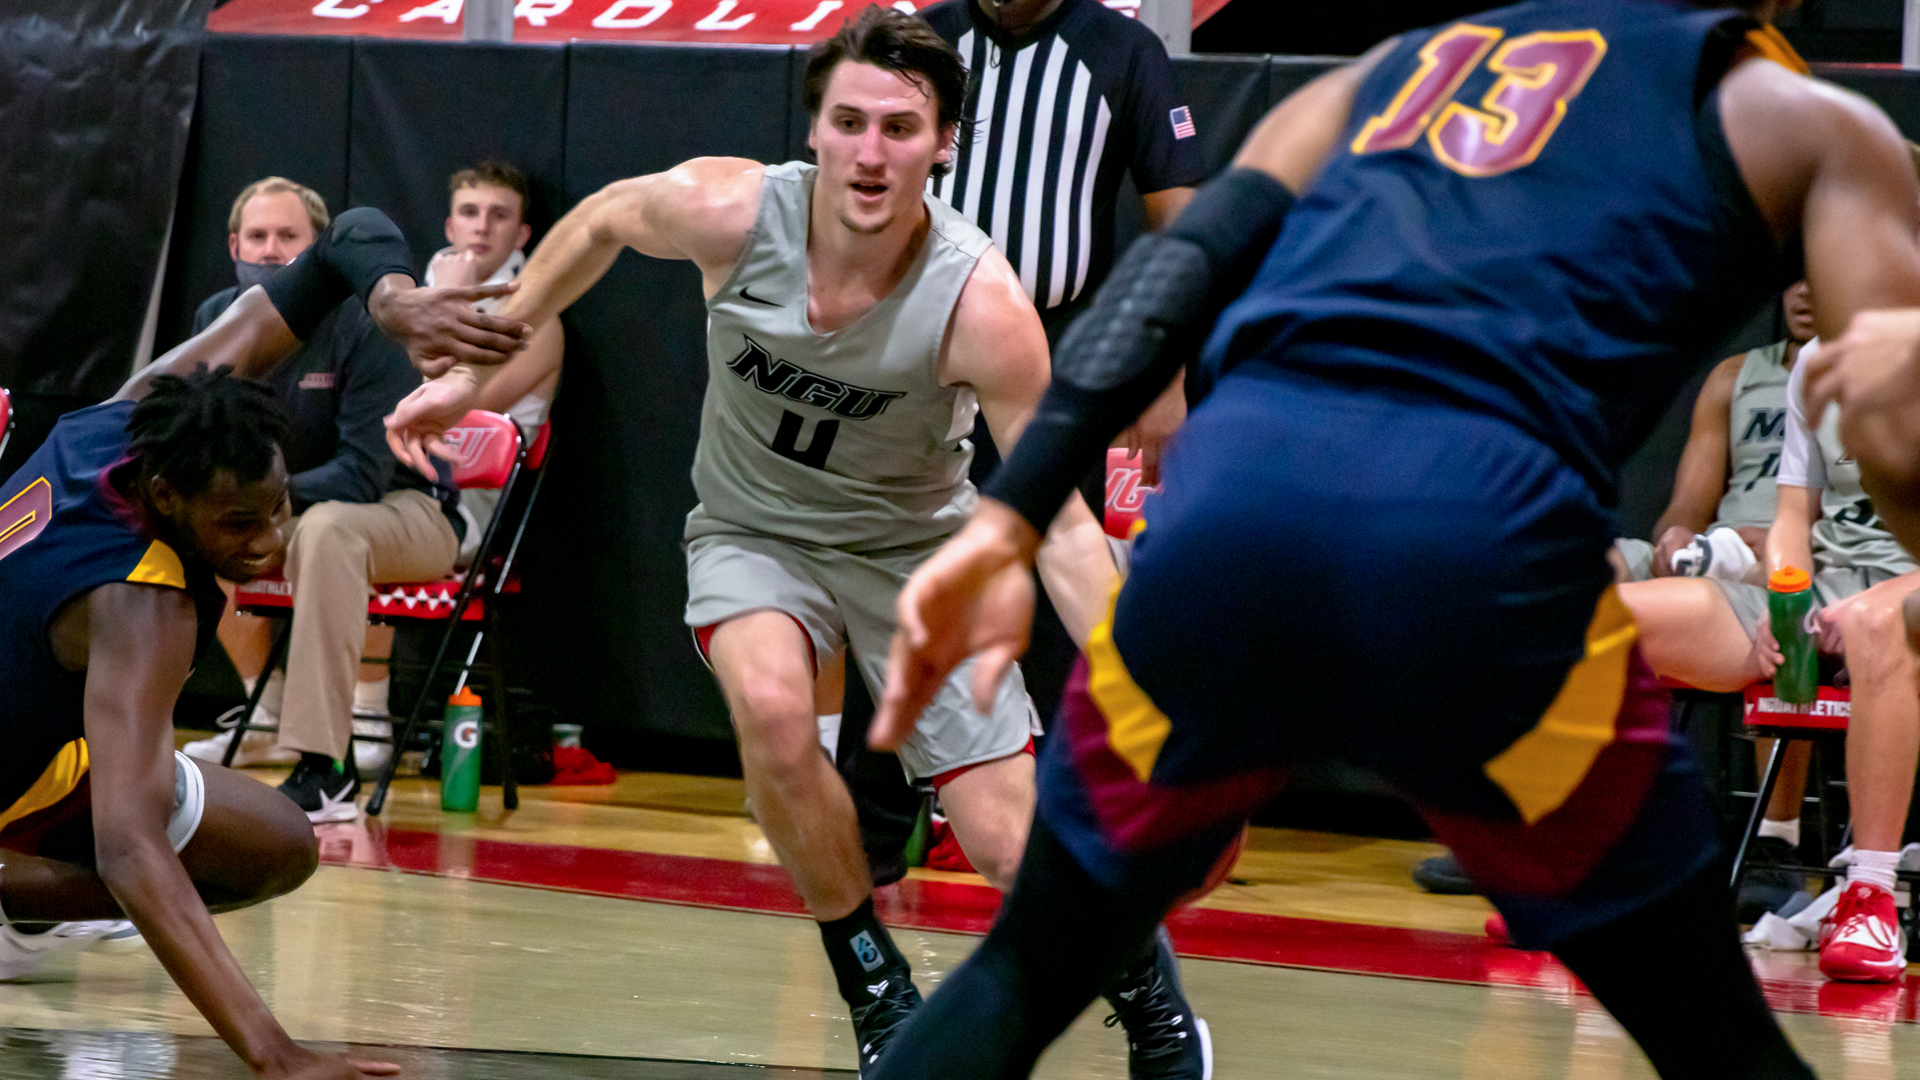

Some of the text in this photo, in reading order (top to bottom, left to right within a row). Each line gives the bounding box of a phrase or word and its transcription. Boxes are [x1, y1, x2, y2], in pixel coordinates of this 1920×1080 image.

[312, 0, 1140, 32] CAROLI
[1351, 22, 1607, 177] 13
[726, 333, 908, 420] NGU
[454, 720, 478, 749] G
